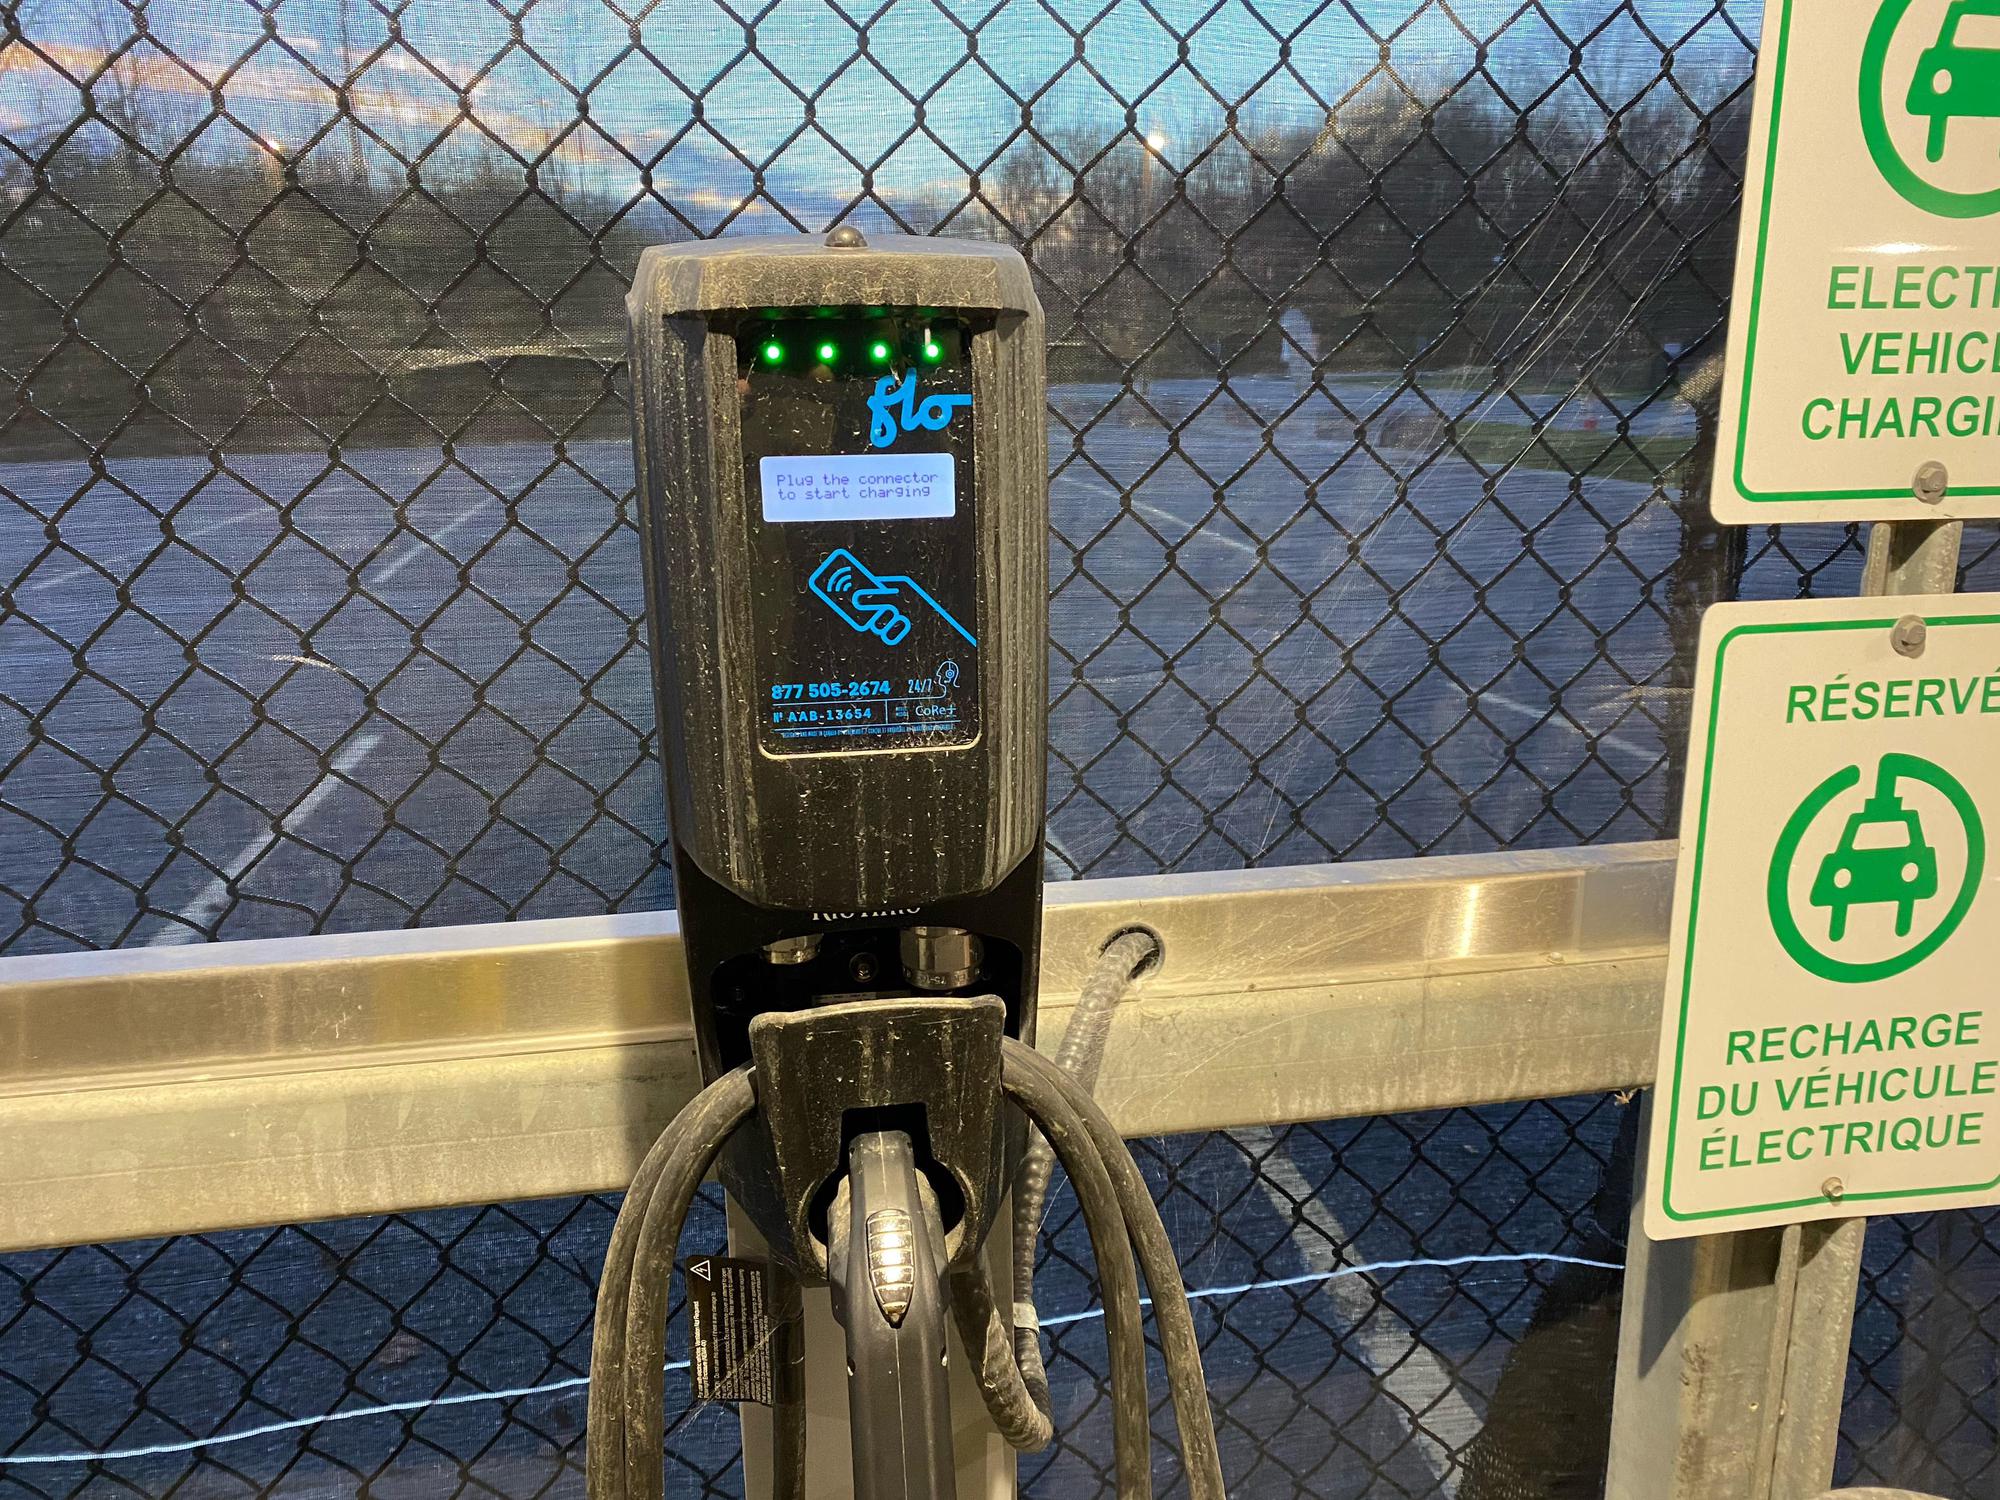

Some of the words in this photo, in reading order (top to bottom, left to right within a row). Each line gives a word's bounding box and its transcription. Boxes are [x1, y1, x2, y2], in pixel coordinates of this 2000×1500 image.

[1827, 266, 2000, 310] ELECT
[867, 368, 972, 448] flo
[1802, 395, 2000, 440] CHARGI
[776, 474, 814, 487] Plug
[823, 473, 850, 486] the
[858, 472, 939, 485] connector
[778, 488, 797, 501] to
[804, 487, 851, 500] start
[859, 486, 931, 499] charging
[771, 684, 804, 700] 877
[808, 680, 891, 699] 505-2674
[908, 679, 932, 694] 24/7
[788, 708, 872, 723] AAB-13654
[1726, 1011, 1983, 1066] RECHARGE
[1696, 1081, 1761, 1121] DU
[1775, 1061, 1998, 1112] VÉHICULE
[1699, 1112, 1984, 1172] ÉLECTRIQUE
